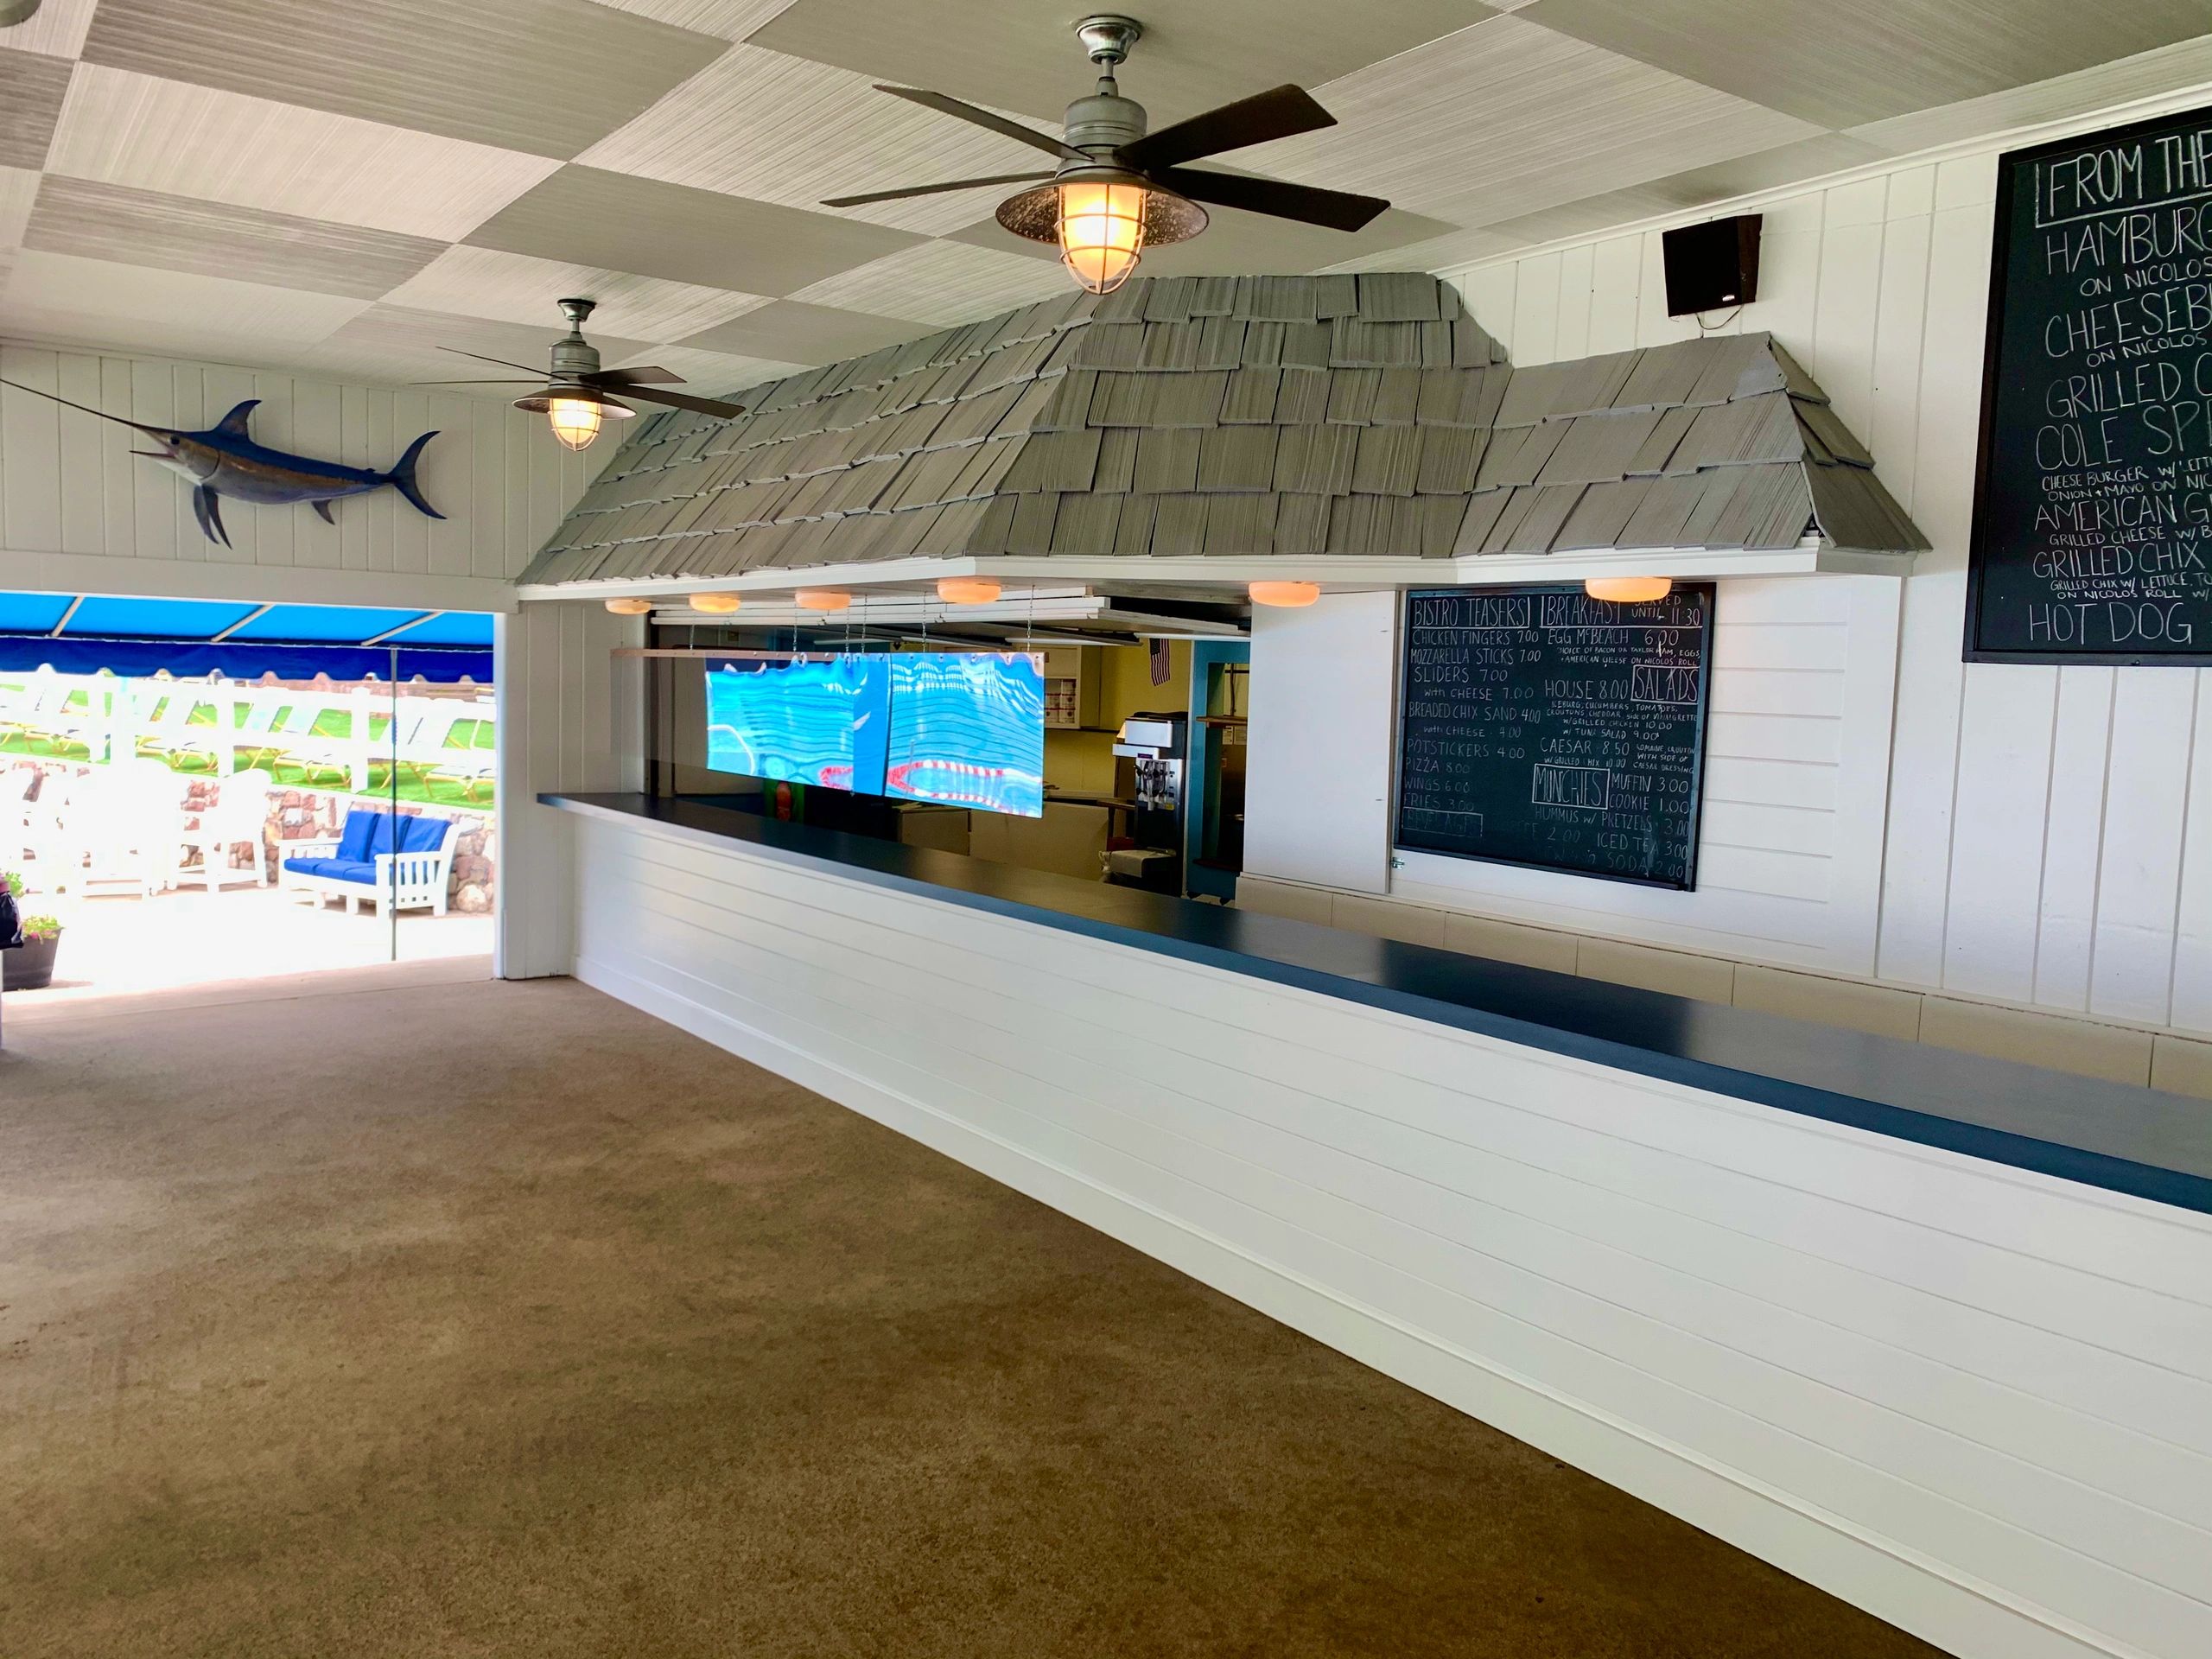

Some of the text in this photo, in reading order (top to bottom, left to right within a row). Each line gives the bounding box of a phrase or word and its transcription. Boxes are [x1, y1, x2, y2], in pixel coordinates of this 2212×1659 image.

[2050, 129, 2212, 217] FROM THE
[2080, 257, 2212, 296] ON NICOLOS
[2045, 283, 2212, 358] CHEESEB
[2086, 332, 2207, 366] ON NICOLOS
[2046, 362, 2181, 418] GRILLED
[2036, 416, 2123, 470] COLE
[2042, 474, 2082, 491] CHEESE
[2088, 466, 2149, 486] BURGER
[2048, 489, 2092, 502] ONION
[2104, 482, 2144, 497] MAYO
[2152, 479, 2177, 491] ON
[2035, 492, 2212, 531] AMERICAN G
[2050, 533, 2106, 547] GRILLED
[2111, 526, 2166, 544] CHEESE
[2033, 542, 2206, 578] GRILLED CHIX
[2050, 580, 2088, 591] GRILLED
[2093, 579, 2118, 589] CHIX
[2085, 590, 2138, 600] NICOLOS
[2145, 589, 2182, 598] ROLL
[1414, 598, 1525, 626] BISTRO TEASERS
[2030, 601, 2191, 645] HOT DOG
[1413, 629, 1458, 645] CHICKEN
[1462, 631, 1510, 645] FINGERS
[1548, 629, 1571, 644] EGG
[1410, 649, 1469, 664] MOZZARELLA
[1476, 649, 1513, 665] STICKS
[1414, 666, 1469, 683] SLIDERS
[1635, 666, 1698, 701] SALADS
[1451, 689, 1492, 701] CHEESE
[1545, 679, 1593, 700] HOUSE
[1409, 702, 1450, 718] BREADED
[1453, 704, 1478, 719] CHIX
[1484, 707, 1516, 721] SAND
[1446, 726, 1485, 737] CHEESE
[1601, 729, 1626, 740] SALAD
[1407, 739, 1489, 757] POTSTICKERS
[1541, 737, 1592, 754] CAESAR
[1406, 757, 1439, 772] PIZZA
[1404, 777, 1440, 791] WINGS
[1535, 767, 1602, 806] MUNCHIES
[1611, 772, 1652, 791] MUFFIN
[1403, 792, 1440, 809] FRIES
[1609, 794, 1649, 810] COOKIE
[1535, 807, 1579, 823] HUMMUS
[1602, 811, 1652, 832] PRETZELS
[1597, 832, 1628, 849] ICED
[1633, 837, 1658, 855] TEA
[1607, 852, 1647, 871] SODA
